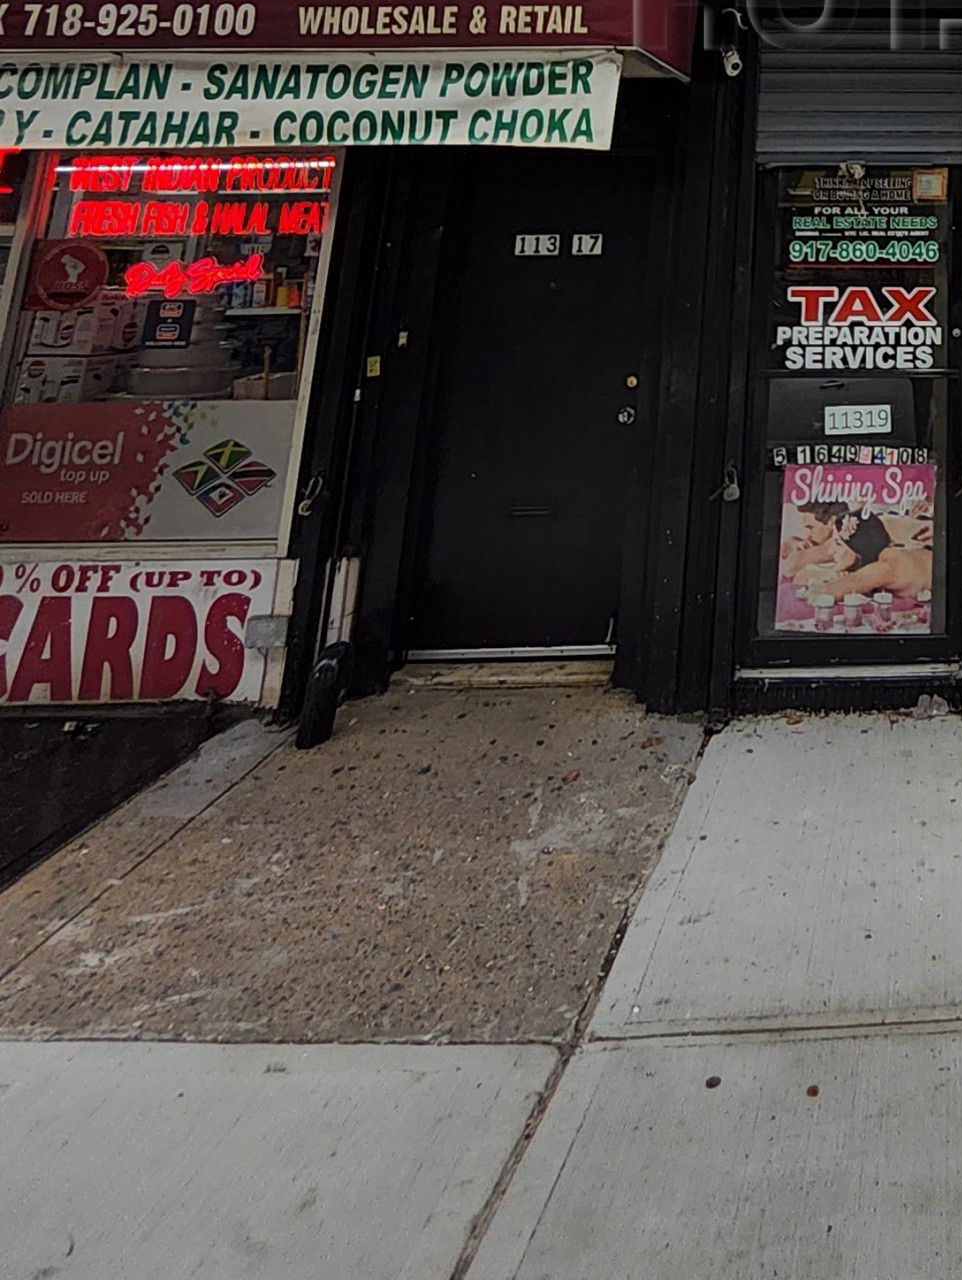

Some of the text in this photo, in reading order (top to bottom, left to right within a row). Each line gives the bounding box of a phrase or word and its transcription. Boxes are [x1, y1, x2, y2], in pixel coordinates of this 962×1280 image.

[24, 3, 256, 36] 718-925-0100
[298, 6, 459, 35] WHOLESALE
[469, 6, 487, 34] &
[499, 5, 588, 34] RETAIL
[203, 63, 430, 100] SANATOGEN
[439, 59, 594, 97] POWDER
[65, 110, 239, 147] CATAHAR
[273, 110, 457, 145] COCONUT
[467, 108, 594, 144] CHOKA
[814, 207, 840, 215] FOR
[872, 207, 909, 215] YOUR
[792, 217, 938, 229] REAL ESTATE NEEDS
[519, 235, 600, 253] 113 17
[790, 241, 938, 261] 917-860-4046
[787, 286, 937, 326] TAX
[777, 327, 942, 346] PREPARATION
[785, 346, 934, 369] SERVICES
[828, 409, 889, 430] 11319
[6, 432, 125, 474] Digicel
[60, 470, 110, 484] top up
[21, 491, 88, 504] SOLD HERE
[791, 465, 927, 520] Shining Spa
[51, 564, 122, 593] OFF
[129, 570, 192, 592] (UP
[200, 570, 262, 591] TO)
